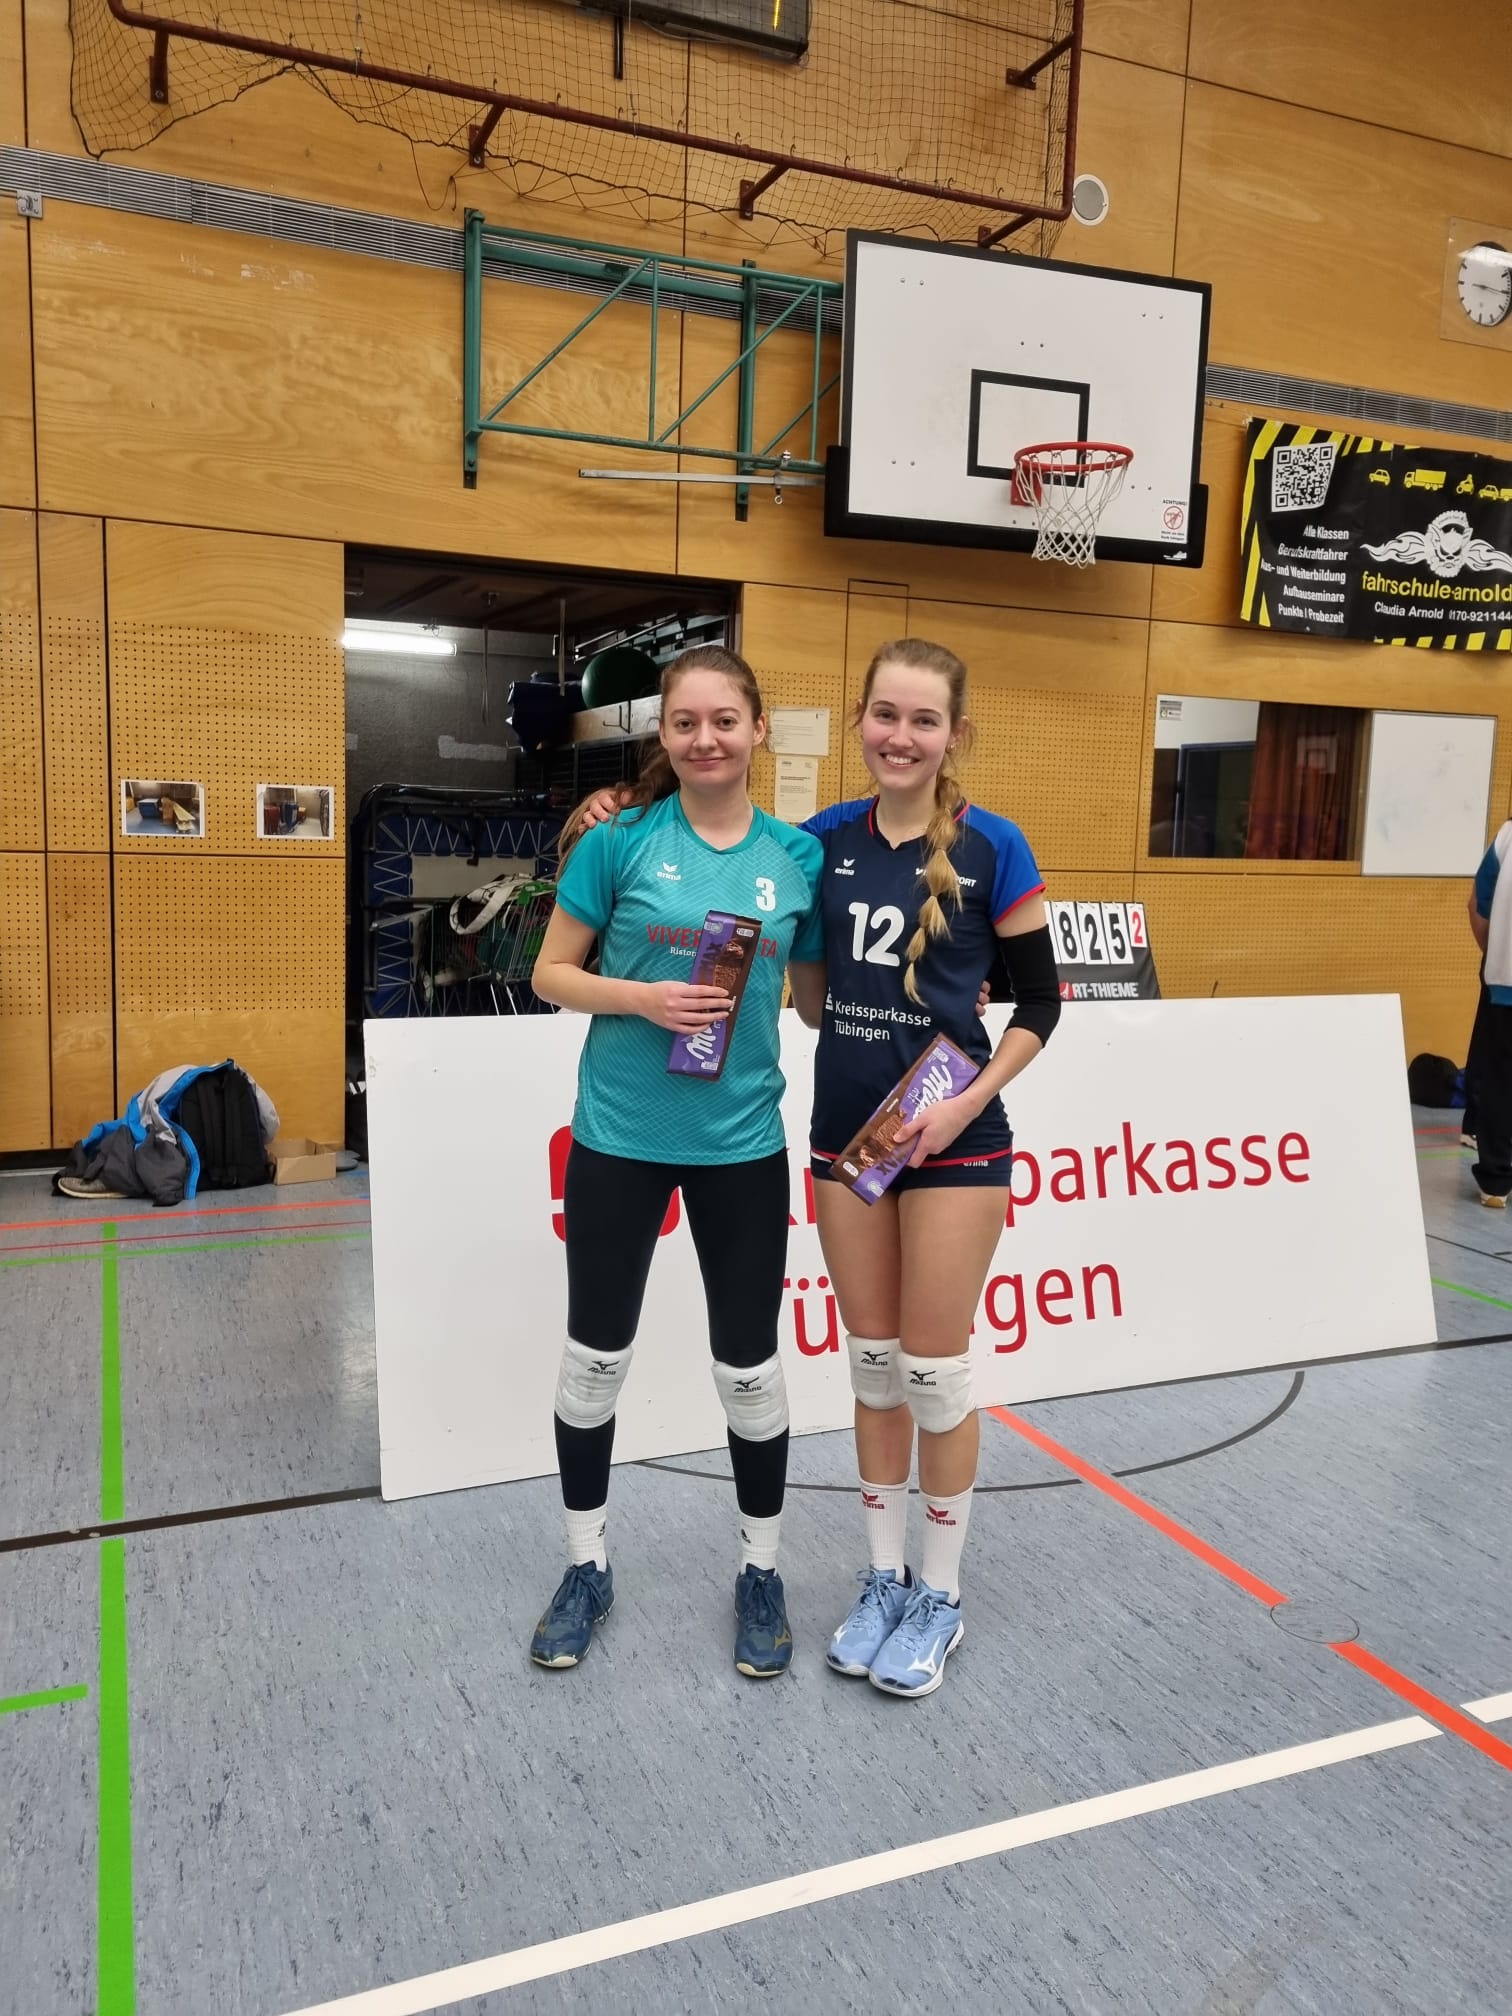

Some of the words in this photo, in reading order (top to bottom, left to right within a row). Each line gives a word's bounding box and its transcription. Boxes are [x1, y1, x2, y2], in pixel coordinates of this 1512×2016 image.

[1303, 525, 1316, 538] Alle
[1317, 526, 1349, 540] Klassen
[1278, 542, 1348, 561] Berufskraftfahrer
[1277, 565, 1290, 576] und
[1290, 565, 1346, 585] Weiterbildung
[1278, 603, 1304, 618] Punkte
[1308, 608, 1344, 623] Probezeit
[1374, 601, 1406, 616] Claudia
[1408, 606, 1444, 620] Arnold
[834, 867, 855, 876] erima
[755, 877, 776, 912] 3
[849, 901, 905, 967] 12
[835, 1000, 931, 1027] Kreissparkasse
[834, 1020, 890, 1042] Tübingen
[926, 1512, 957, 1526] erima
